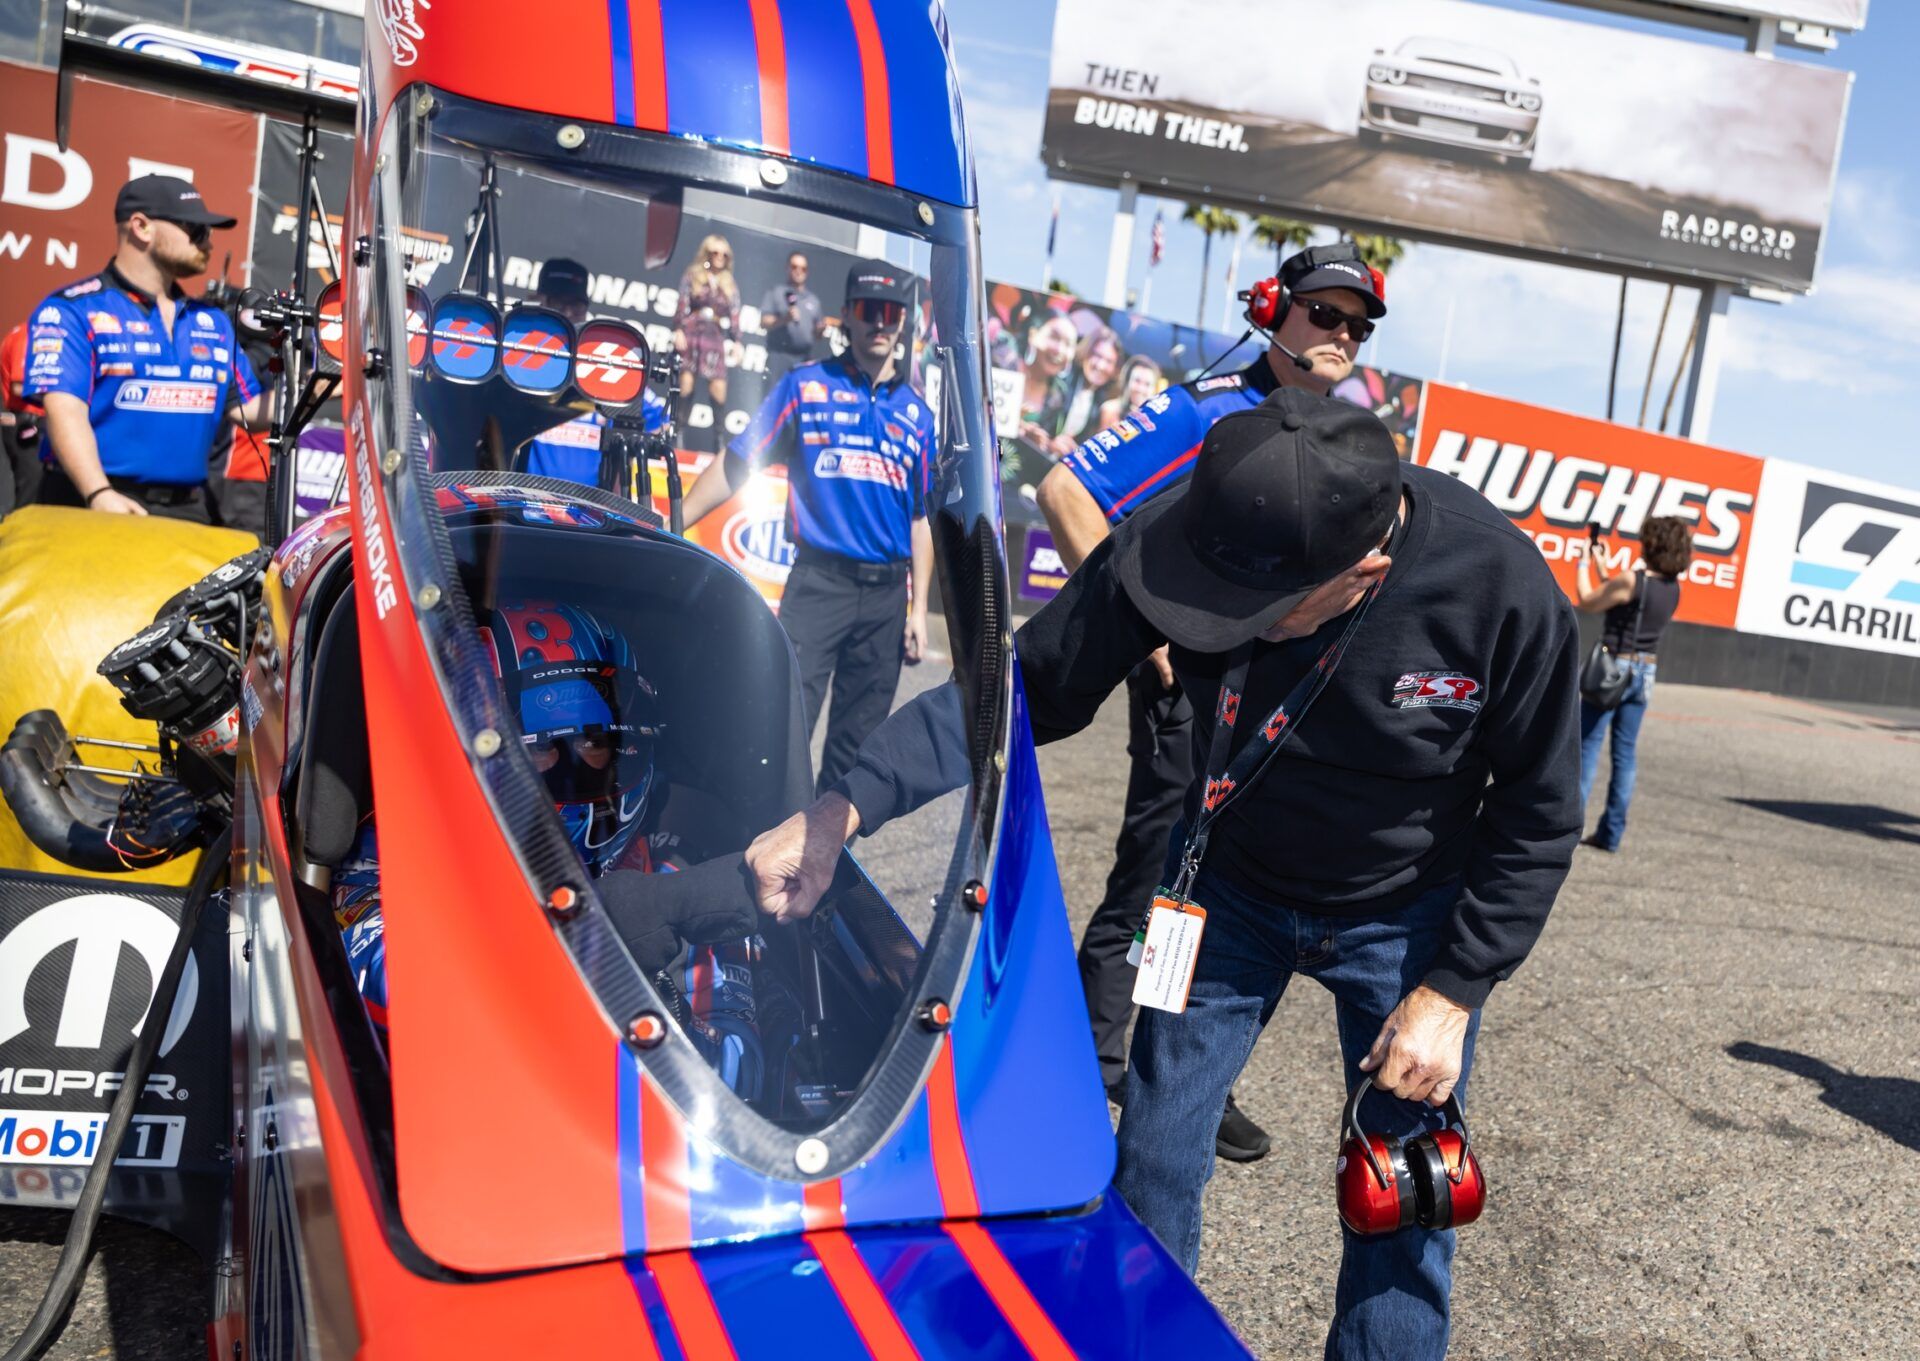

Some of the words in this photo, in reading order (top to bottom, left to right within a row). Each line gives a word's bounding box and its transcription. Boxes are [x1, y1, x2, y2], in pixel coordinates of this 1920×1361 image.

[1086, 63, 1159, 95] THEN
[1074, 97, 1159, 136] BURN
[1164, 112, 1249, 153] THEM.
[1661, 210, 1796, 250] RADFORD
[1426, 429, 1754, 551] HUGHES
[1784, 594, 1920, 644] CARRIL
[532, 668, 598, 679] DODGE
[136, 1124, 151, 1157] 1
